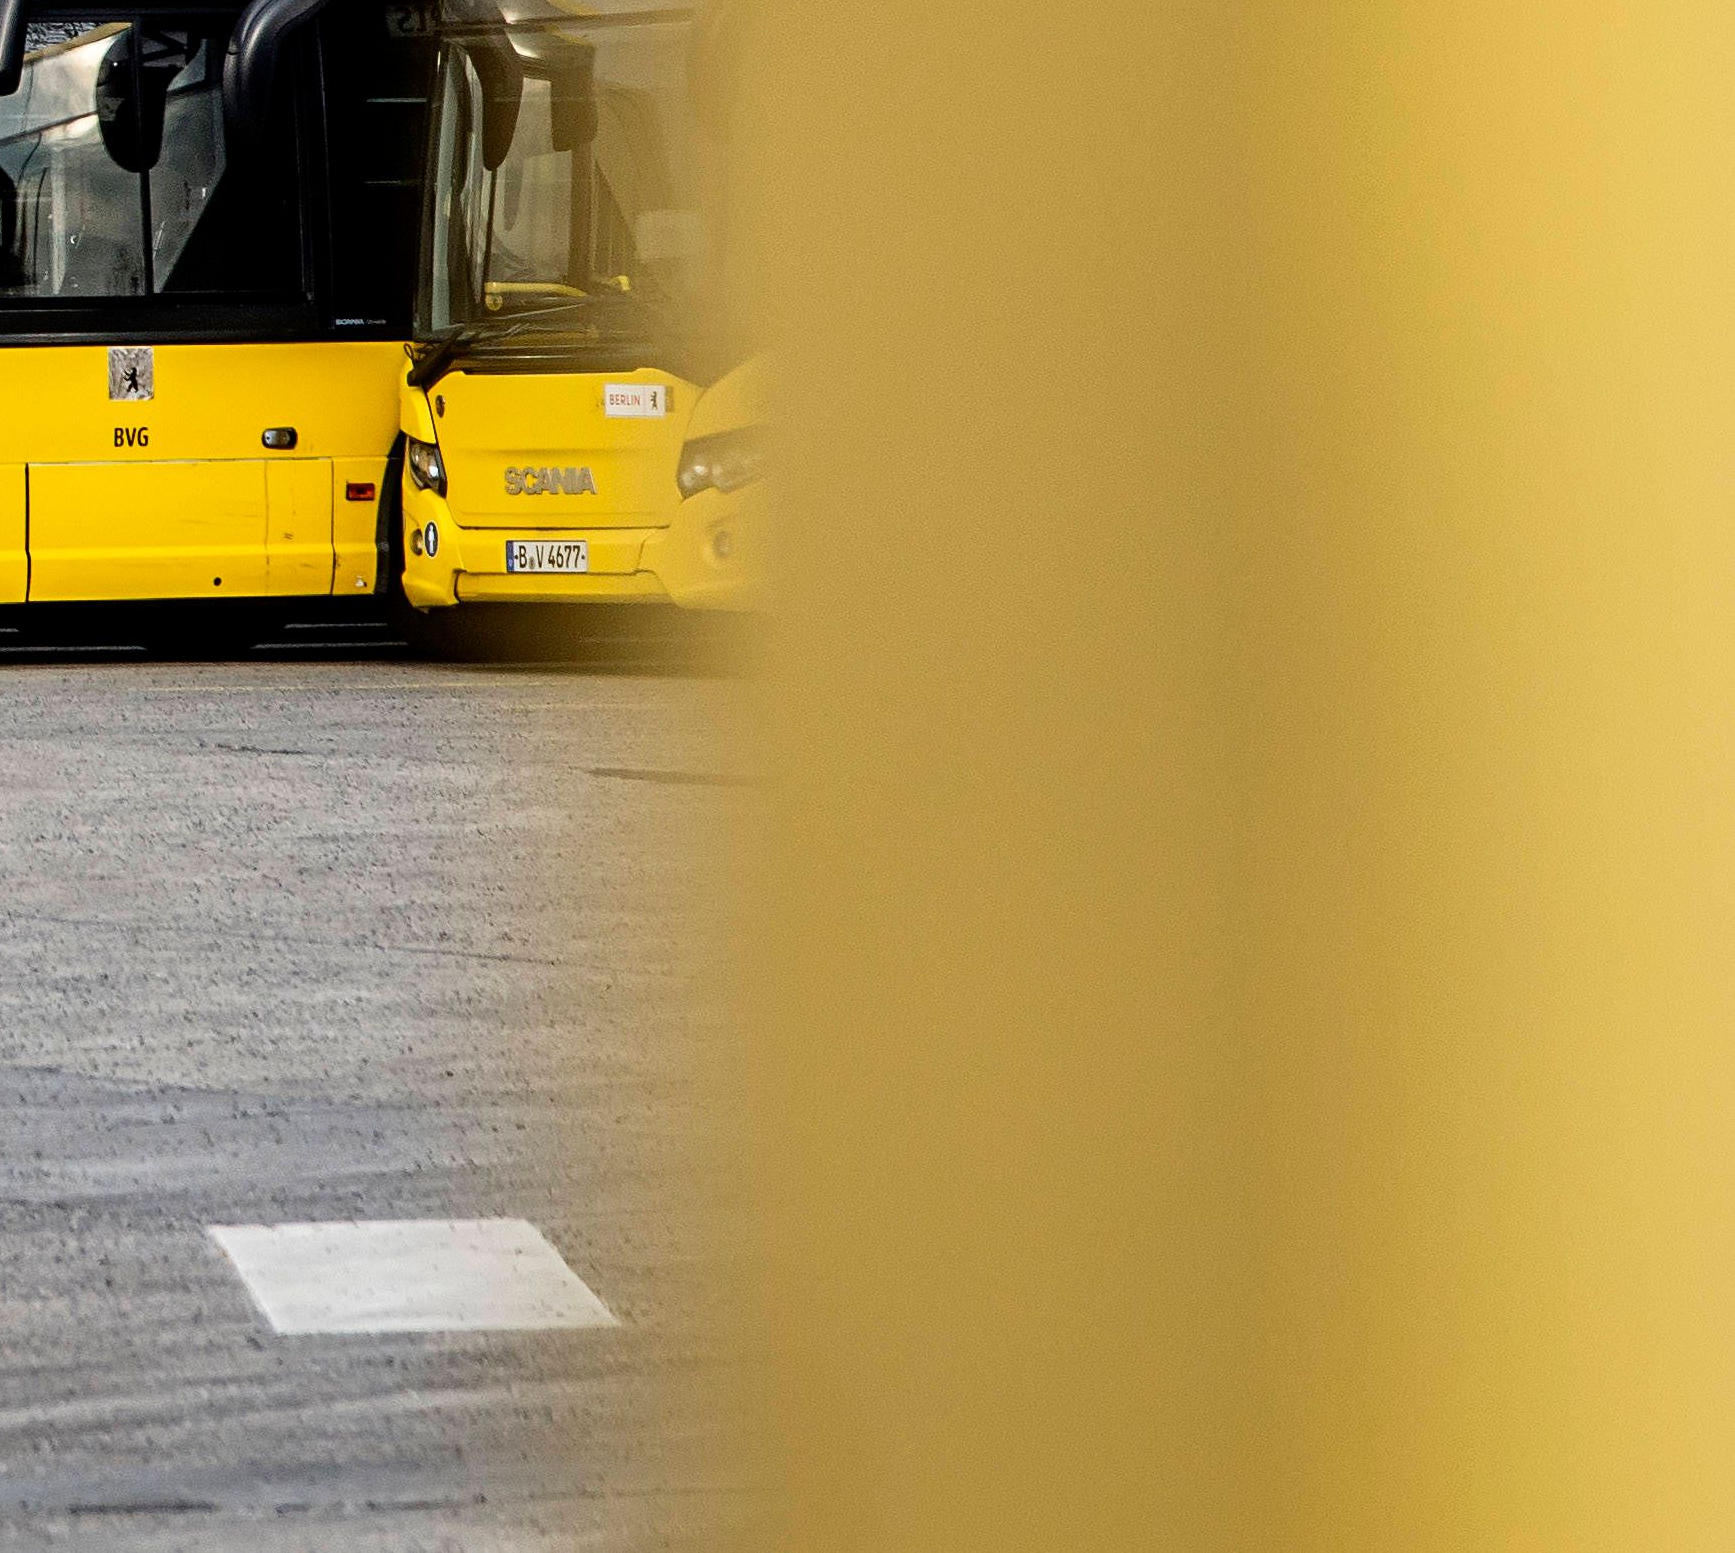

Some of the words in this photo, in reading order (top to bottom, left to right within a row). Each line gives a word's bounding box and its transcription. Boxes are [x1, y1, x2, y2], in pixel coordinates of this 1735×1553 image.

[609, 393, 641, 406] BERLIN
[113, 426, 149, 448] BVG
[504, 466, 598, 496] SCANIA
[548, 545, 582, 569] 4677
